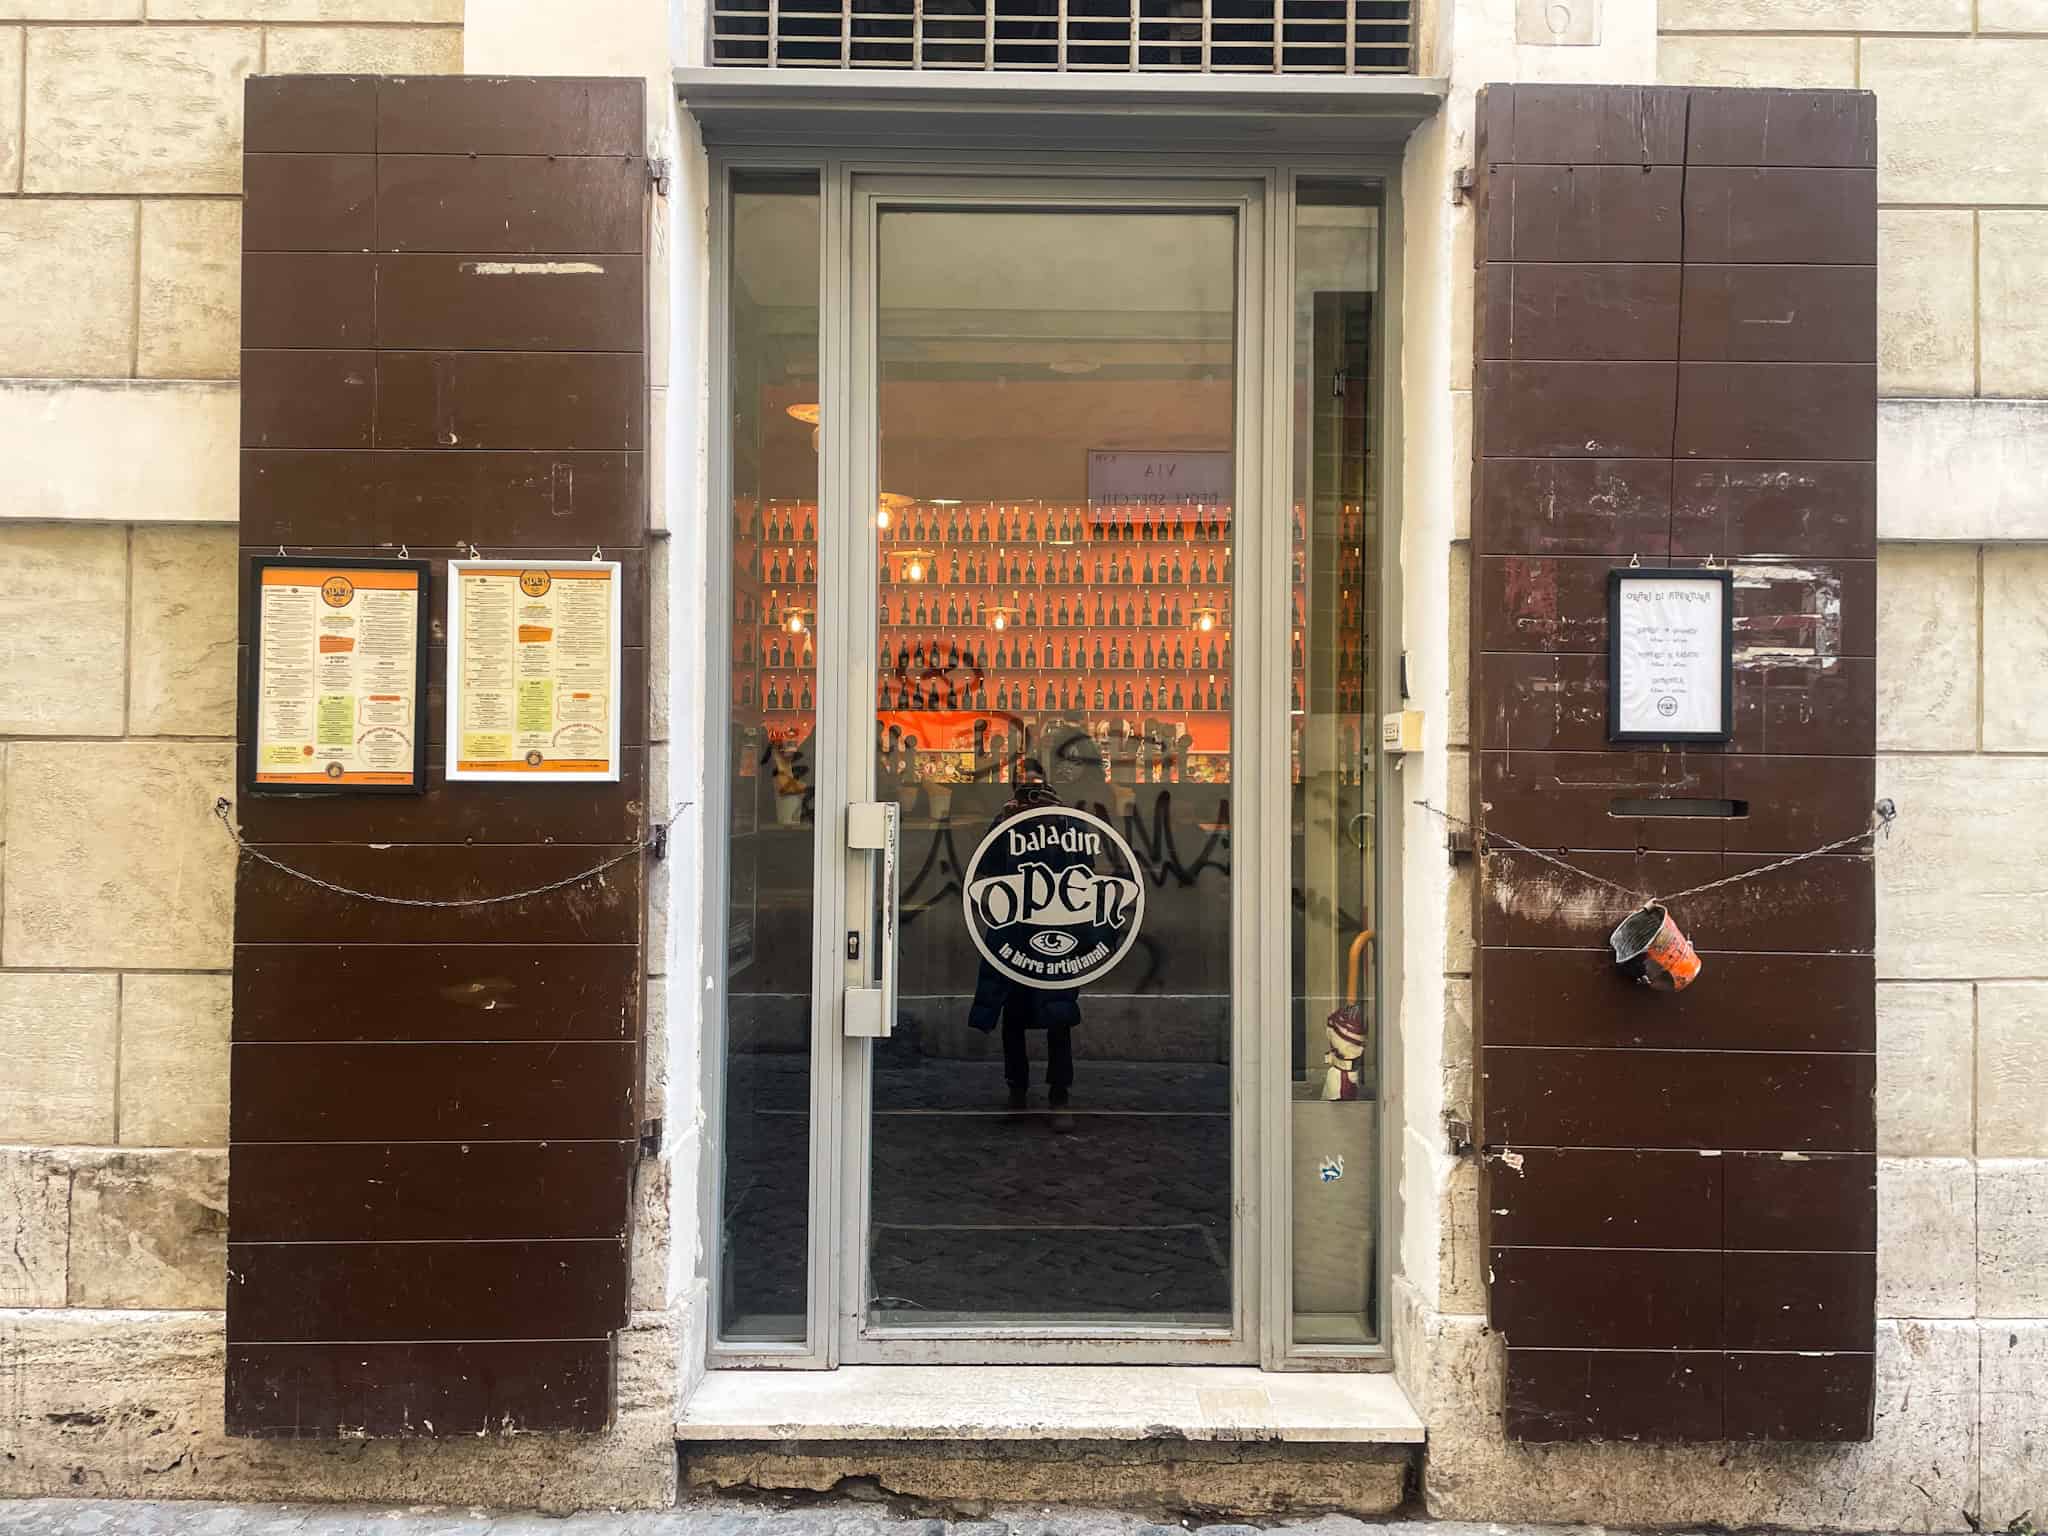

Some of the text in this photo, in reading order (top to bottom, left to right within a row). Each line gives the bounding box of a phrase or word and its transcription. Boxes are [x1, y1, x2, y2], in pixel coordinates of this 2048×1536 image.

[1008, 825, 1102, 856] baladin
[979, 862, 1126, 930] OPEN
[998, 941, 1111, 975] le birre artigianali
